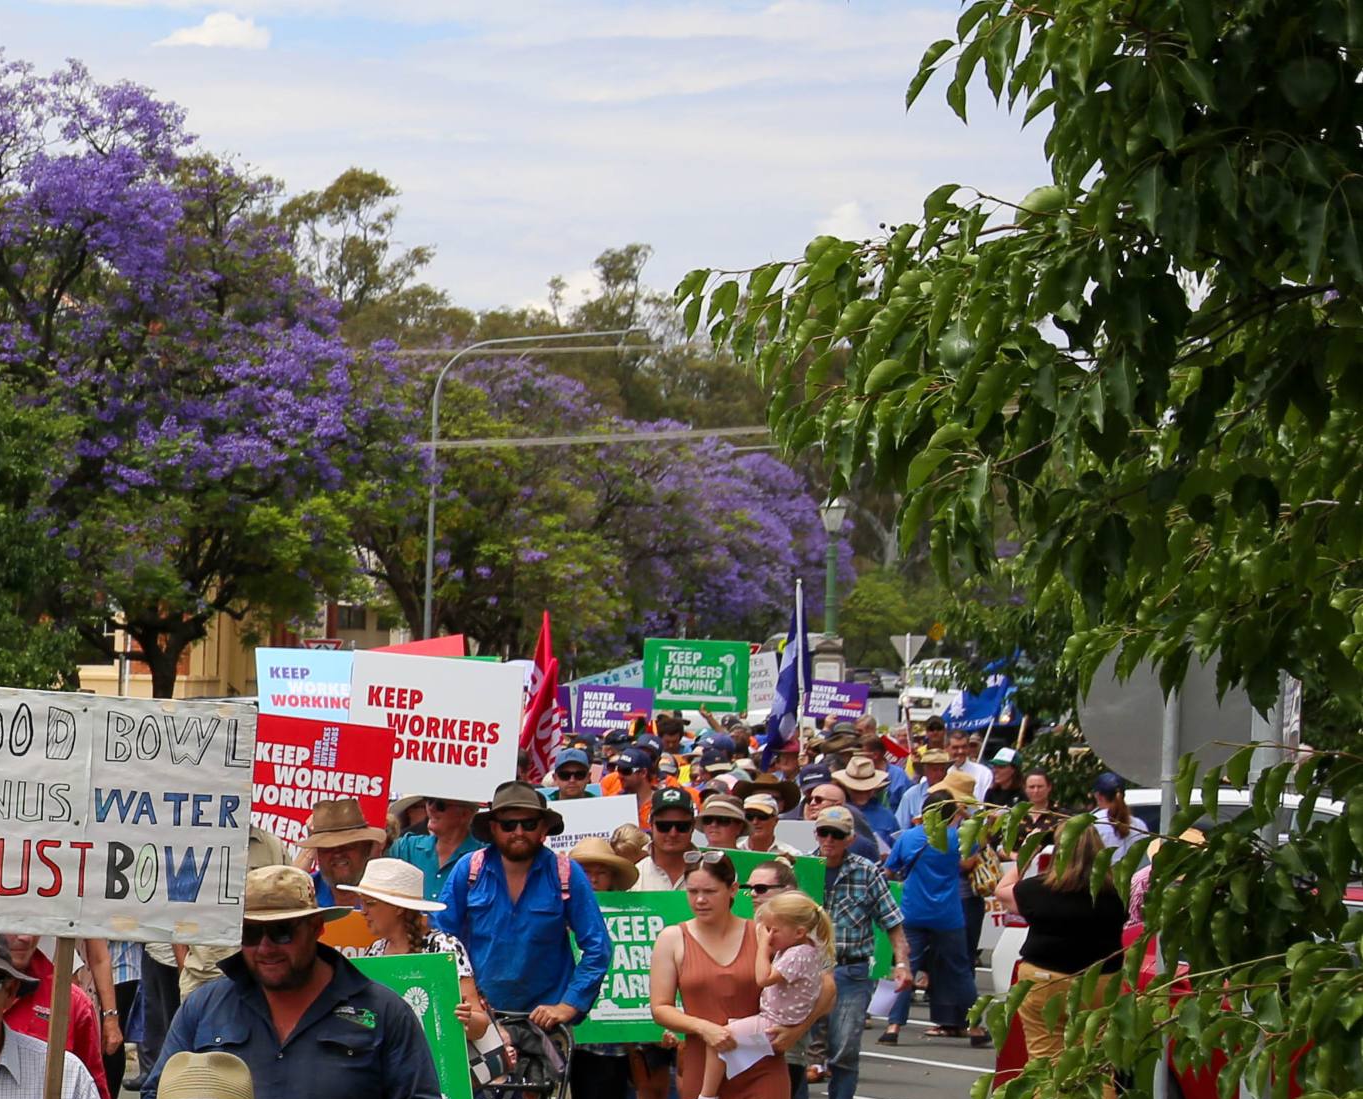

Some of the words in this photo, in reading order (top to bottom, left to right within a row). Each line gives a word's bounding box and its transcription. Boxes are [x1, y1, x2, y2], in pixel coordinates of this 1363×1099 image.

[669, 651, 702, 665] KEEP
[269, 666, 310, 679] KEEP
[665, 665, 723, 678] FARMERS
[289, 681, 350, 697] WORKE
[662, 678, 718, 692] FARMING
[271, 694, 350, 710] WORKING
[367, 685, 424, 711] KEEP
[583, 691, 615, 701] WATER
[583, 701, 632, 711] BUYBACKS
[809, 705, 861, 717] COMMUNITIES
[582, 710, 607, 719] HURT
[387, 713, 500, 744] WORKERS
[105, 711, 251, 768] BOWL
[256, 742, 310, 766] KEEP
[392, 739, 488, 768] ORKING!
[274, 764, 384, 797] WORKERS
[94, 788, 240, 828] WATER
[604, 916, 665, 941] KEEP
